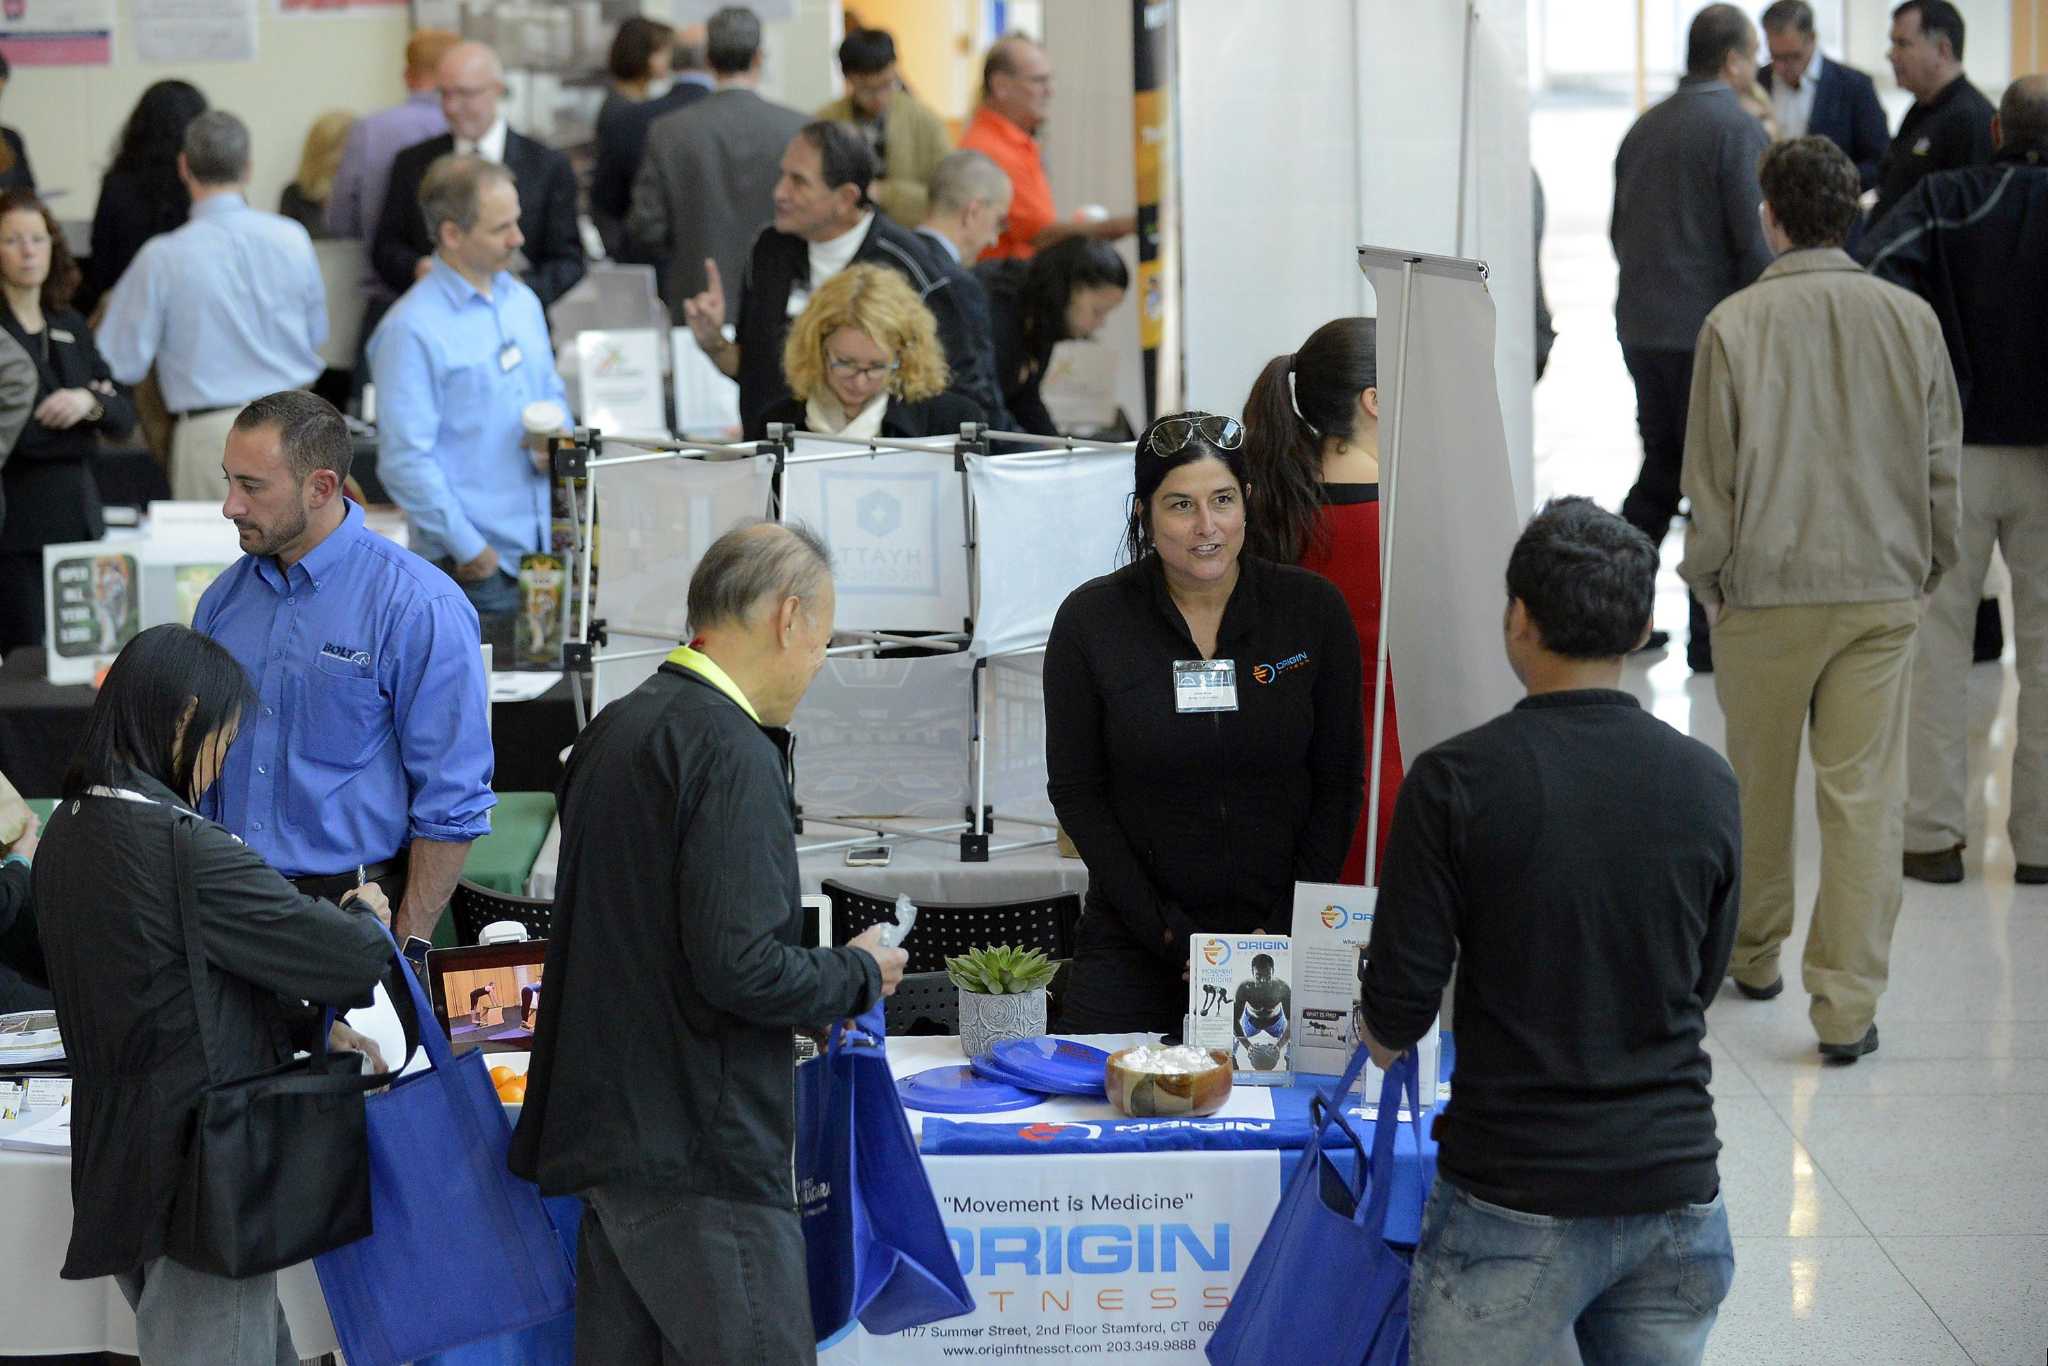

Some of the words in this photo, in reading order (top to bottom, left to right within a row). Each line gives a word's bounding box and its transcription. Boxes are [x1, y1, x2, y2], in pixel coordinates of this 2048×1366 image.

[322, 641, 355, 659] BOLT
[1276, 651, 1308, 671] ORIGIN
[1236, 941, 1289, 950] ORIGIN
[943, 1196, 1060, 1213] "Movement
[1067, 1194, 1084, 1211] is
[1091, 1193, 1194, 1211] Medicine"
[930, 1326, 985, 1338] Summer
[988, 1324, 1031, 1338] Street,
[1036, 1323, 1060, 1336] 2nd
[1064, 1323, 1098, 1335] Floor
[1101, 1321, 1166, 1335] Stamford,
[1170, 1320, 1190, 1332] CT
[943, 1342, 1102, 1357] www.originfitnessct.com
[1106, 1339, 1197, 1353] 203.349.9888
